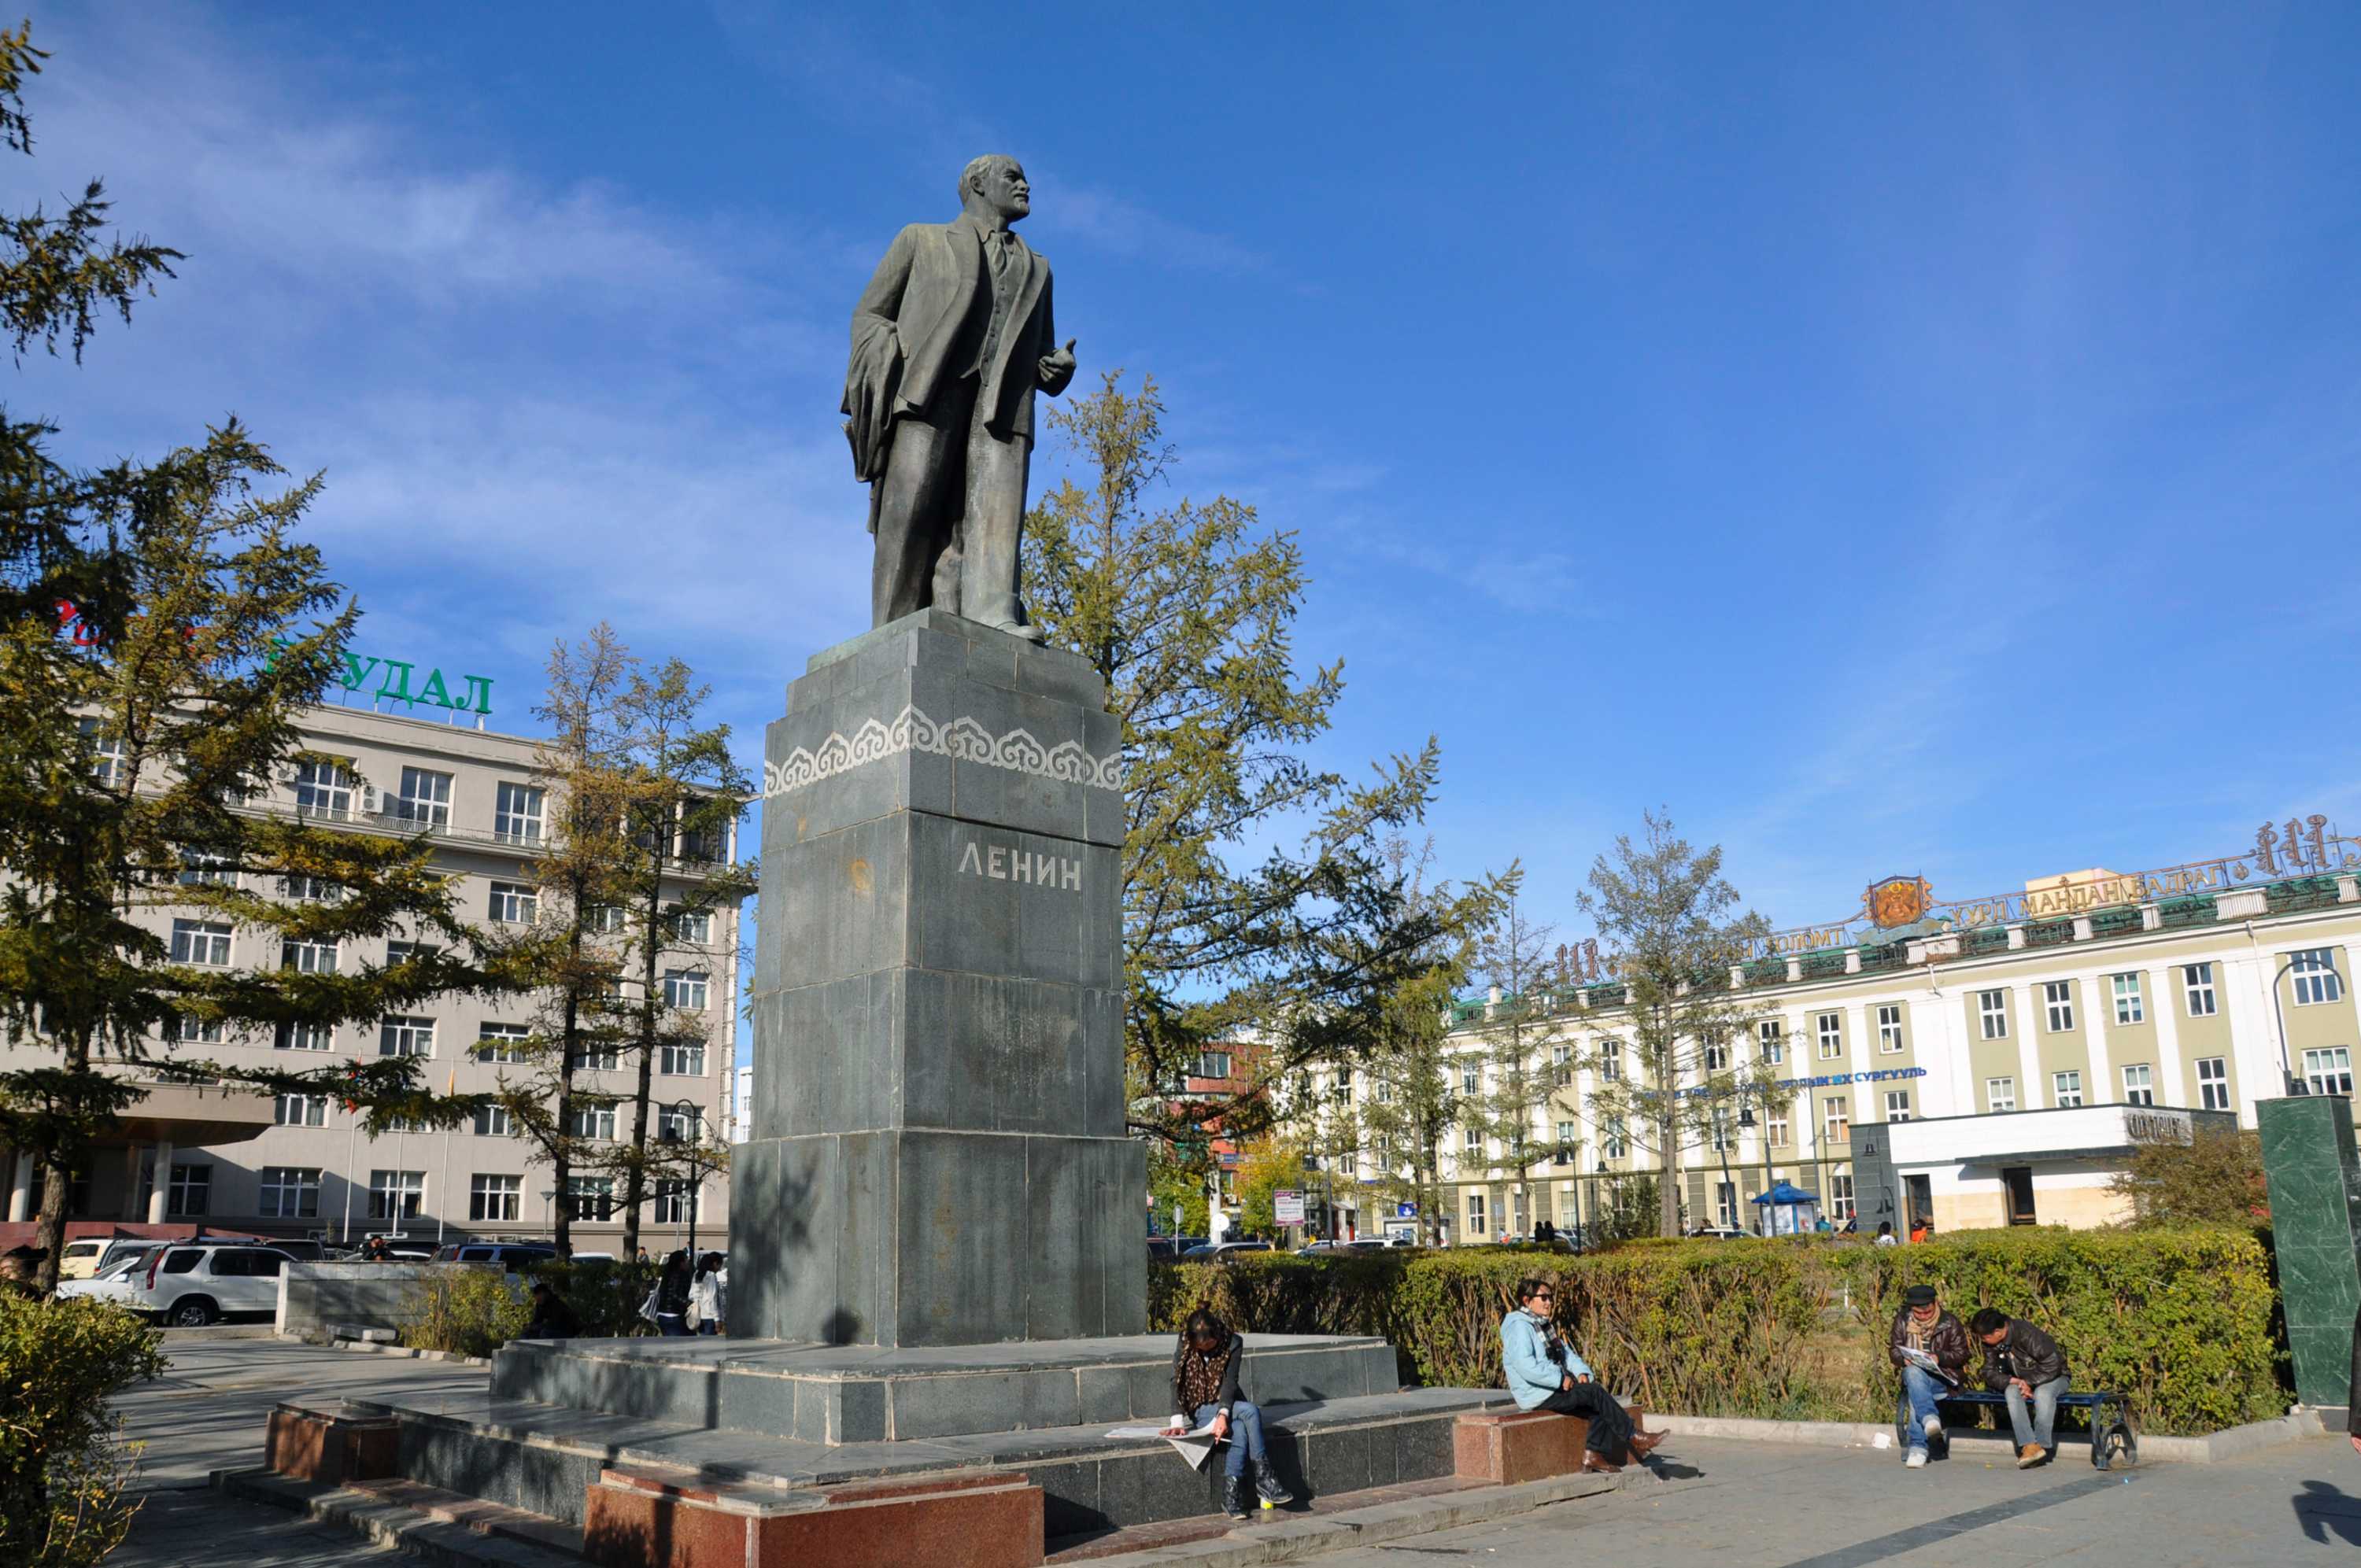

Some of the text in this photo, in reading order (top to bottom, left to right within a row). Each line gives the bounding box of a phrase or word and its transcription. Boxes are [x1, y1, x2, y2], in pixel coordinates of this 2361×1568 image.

[264, 637, 494, 714] УДАЛ
[959, 842, 1082, 891] ЛЕНИН
[2019, 882, 2120, 917] МАНДАН
[2128, 865, 2224, 898] БАДРАГ
[1854, 1067, 1927, 1082] СУРГУУЛЬ
